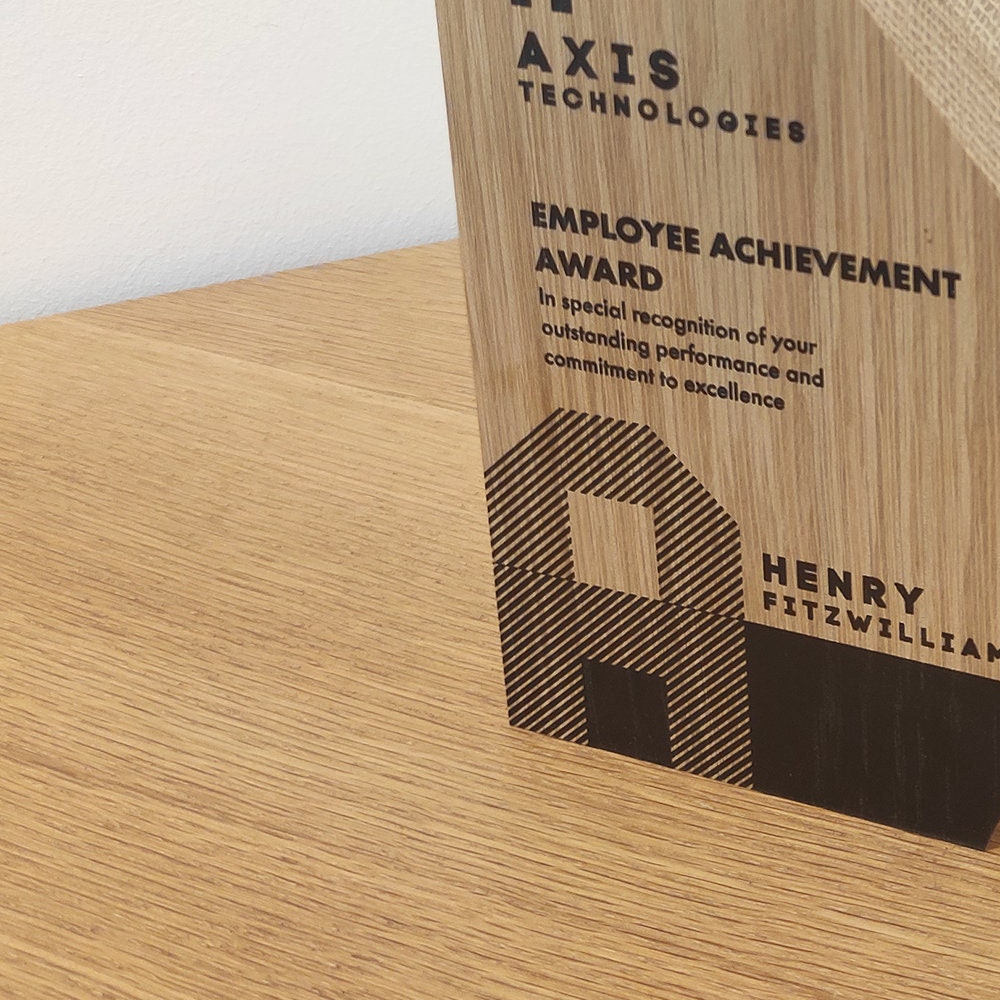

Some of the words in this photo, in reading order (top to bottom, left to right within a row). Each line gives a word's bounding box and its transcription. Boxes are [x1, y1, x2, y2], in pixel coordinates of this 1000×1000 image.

[517, 31, 680, 90] AXIS
[518, 80, 807, 143] TECHNOLOGIES
[531, 201, 700, 254] EMPLOYEE
[709, 233, 962, 299] ACHIEVEMENT
[535, 248, 663, 292] AWARD
[538, 287, 556, 307] In
[561, 297, 627, 321] special
[633, 309, 740, 344] recognition
[746, 326, 768, 347] of
[770, 335, 818, 356] your
[541, 321, 650, 359] outstanding
[656, 344, 780, 380] performance
[786, 366, 825, 388] and
[544, 351, 655, 386] commitment
[660, 372, 678, 390] to
[684, 379, 786, 411] excellence
[762, 552, 925, 616] HENRY
